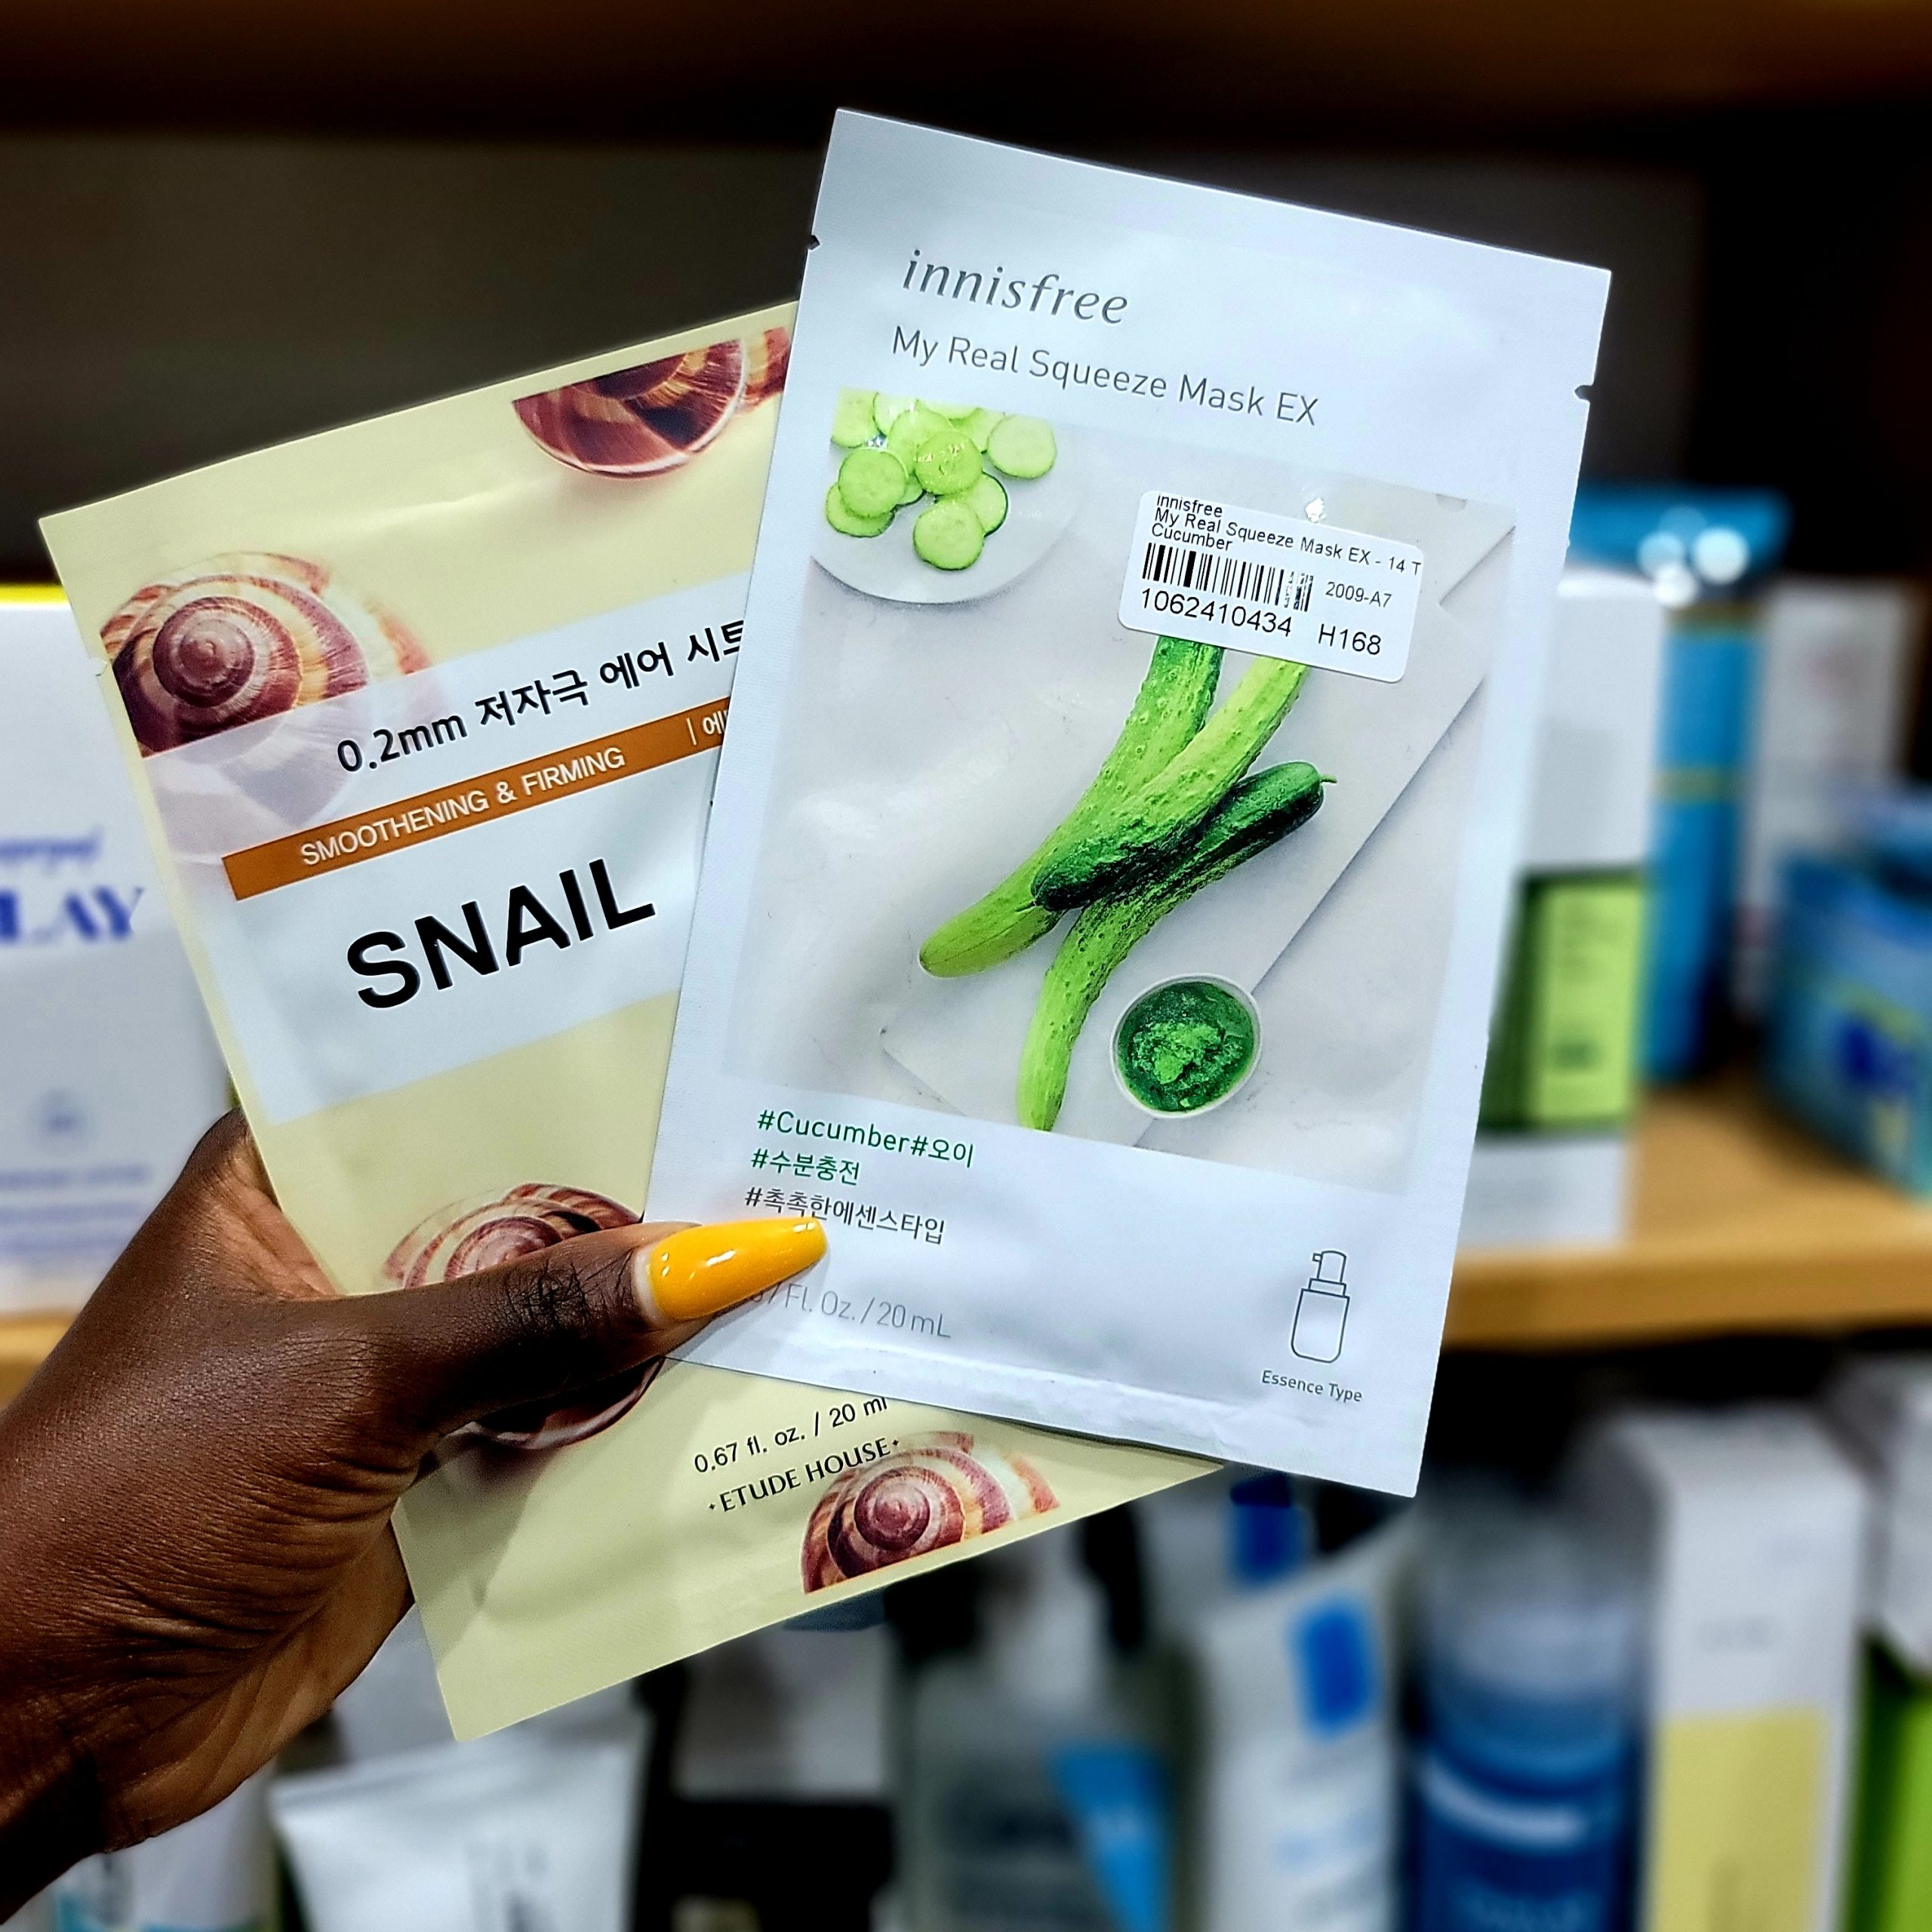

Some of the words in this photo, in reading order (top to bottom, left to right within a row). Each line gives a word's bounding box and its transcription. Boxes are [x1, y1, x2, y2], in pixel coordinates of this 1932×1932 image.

[902, 250, 1128, 325] innisfree
[892, 326, 938, 367] My
[949, 337, 1018, 374] Real
[1029, 349, 1168, 398] Squeeze
[1179, 374, 1264, 417] Mask
[1276, 392, 1319, 426] EX
[1152, 522, 1233, 552] Cucumber
[1157, 494, 1223, 518] innisfree
[1155, 506, 1180, 528] My
[1185, 513, 1221, 534] Real
[1226, 521, 1294, 549] Squeeze
[1300, 537, 1343, 559] Mask
[1349, 547, 1371, 566] EX
[1389, 556, 1404, 573] 14
[1411, 561, 1422, 576] T
[1141, 588, 1293, 637] 1062410434
[1325, 581, 1392, 608] 2009-A7
[1318, 623, 1382, 656] H168
[337, 713, 468, 773] 0.2mm
[475, 669, 589, 732] 저자극
[598, 642, 674, 690] 에어
[300, 790, 490, 867] SMOOTHENING
[496, 781, 518, 804] &
[521, 746, 626, 795] FIRMING
[346, 858, 656, 1009] SNAIL
[751, 1148, 860, 1186] #수분충전
[745, 1187, 945, 1245] #촉촉한에센스타입
[1262, 1370, 1324, 1395] Essence
[1328, 1383, 1362, 1404] Type
[694, 1442, 737, 1472] 0.67
[747, 1435, 768, 1456] fl.
[774, 1427, 805, 1446] oz.
[829, 1404, 855, 1428] 20
[719, 1469, 801, 1512] ETUDE
[804, 1437, 891, 1483] HOUSE
